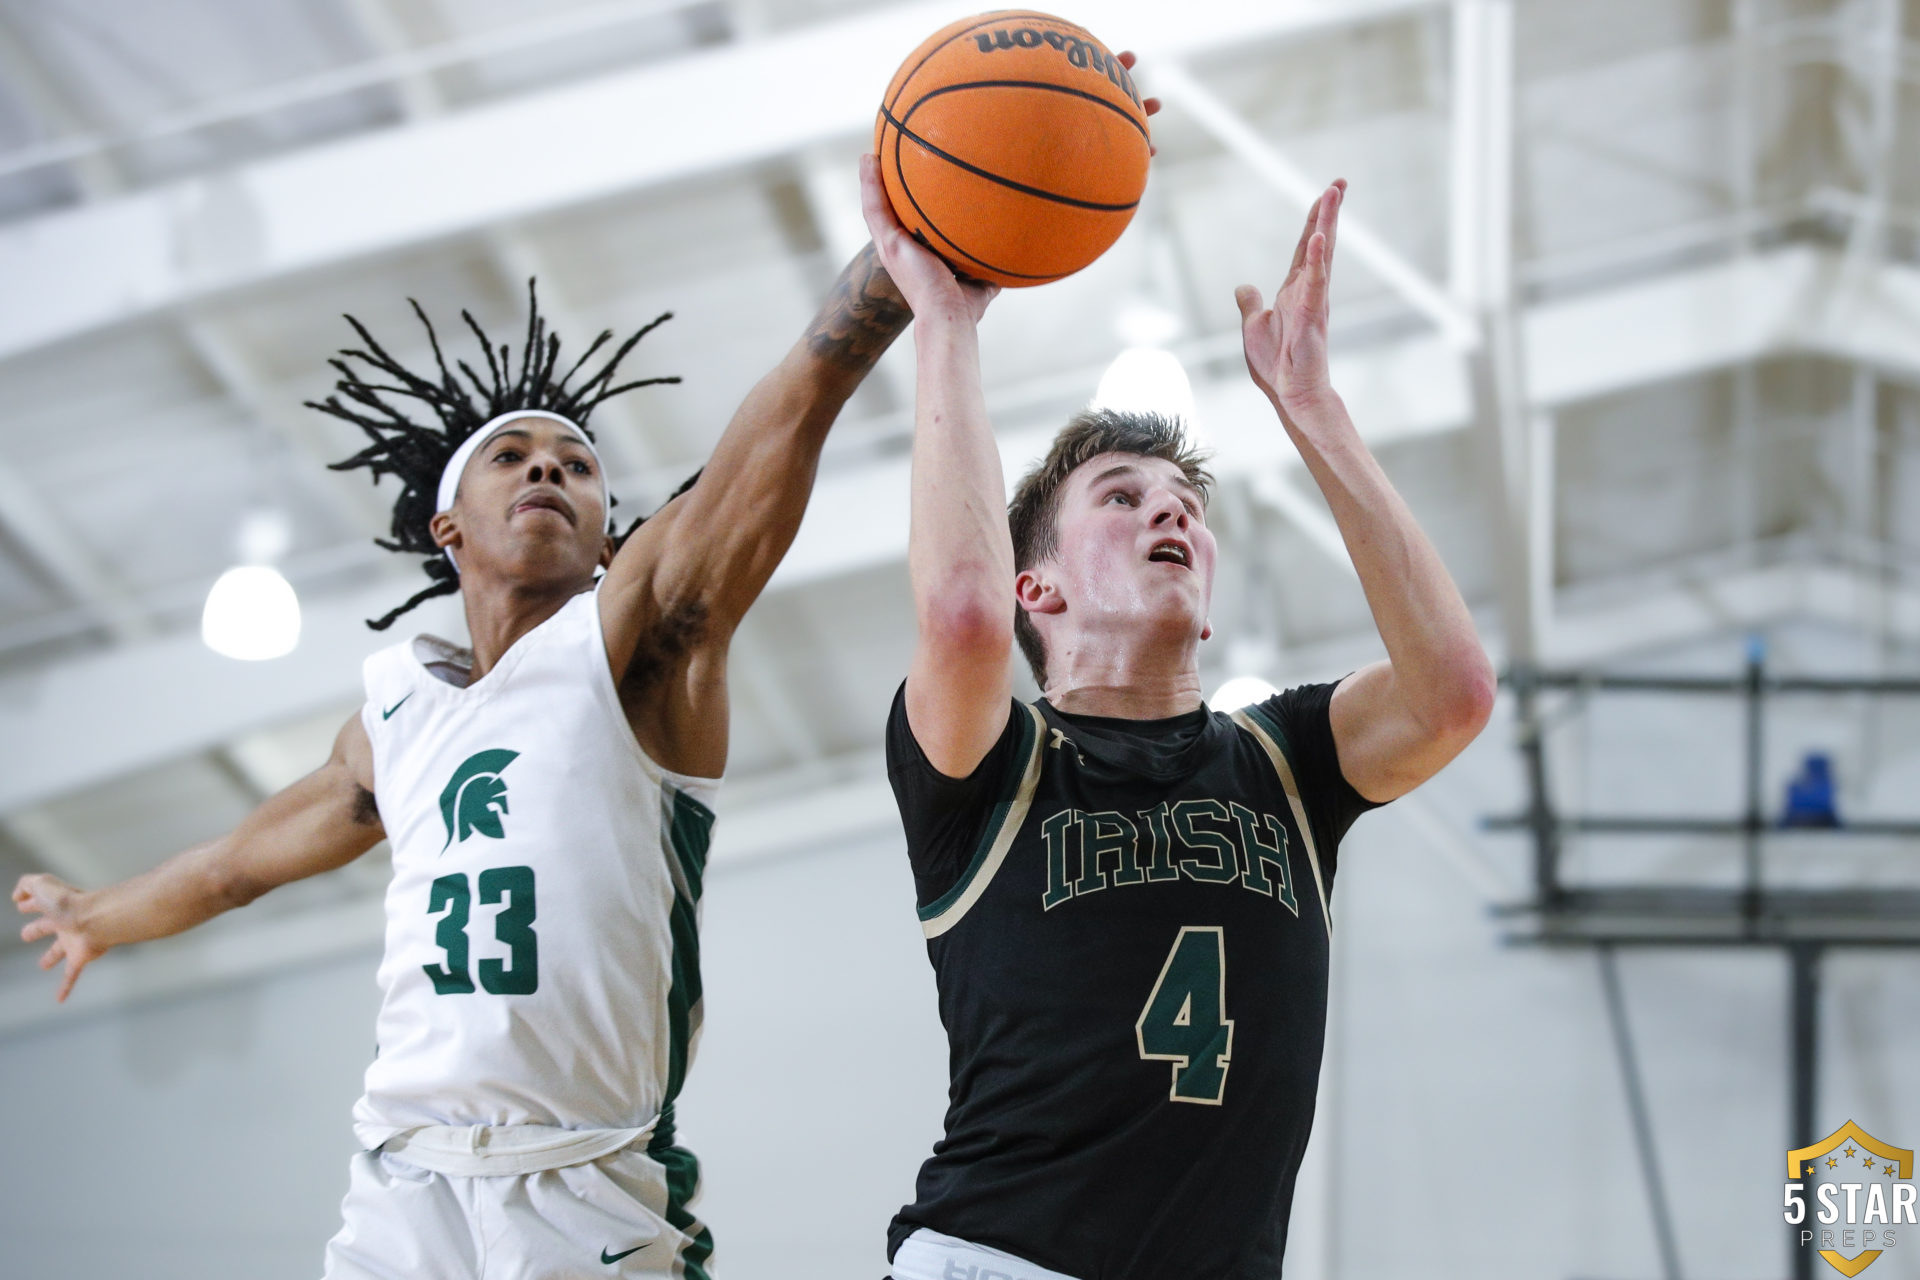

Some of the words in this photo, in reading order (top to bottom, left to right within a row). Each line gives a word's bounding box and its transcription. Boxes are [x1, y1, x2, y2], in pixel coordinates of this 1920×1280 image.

[972, 28, 1142, 111] Wilson
[1041, 799, 1298, 918] IRISH
[422, 866, 538, 995] 33
[1135, 926, 1234, 1105] 4
